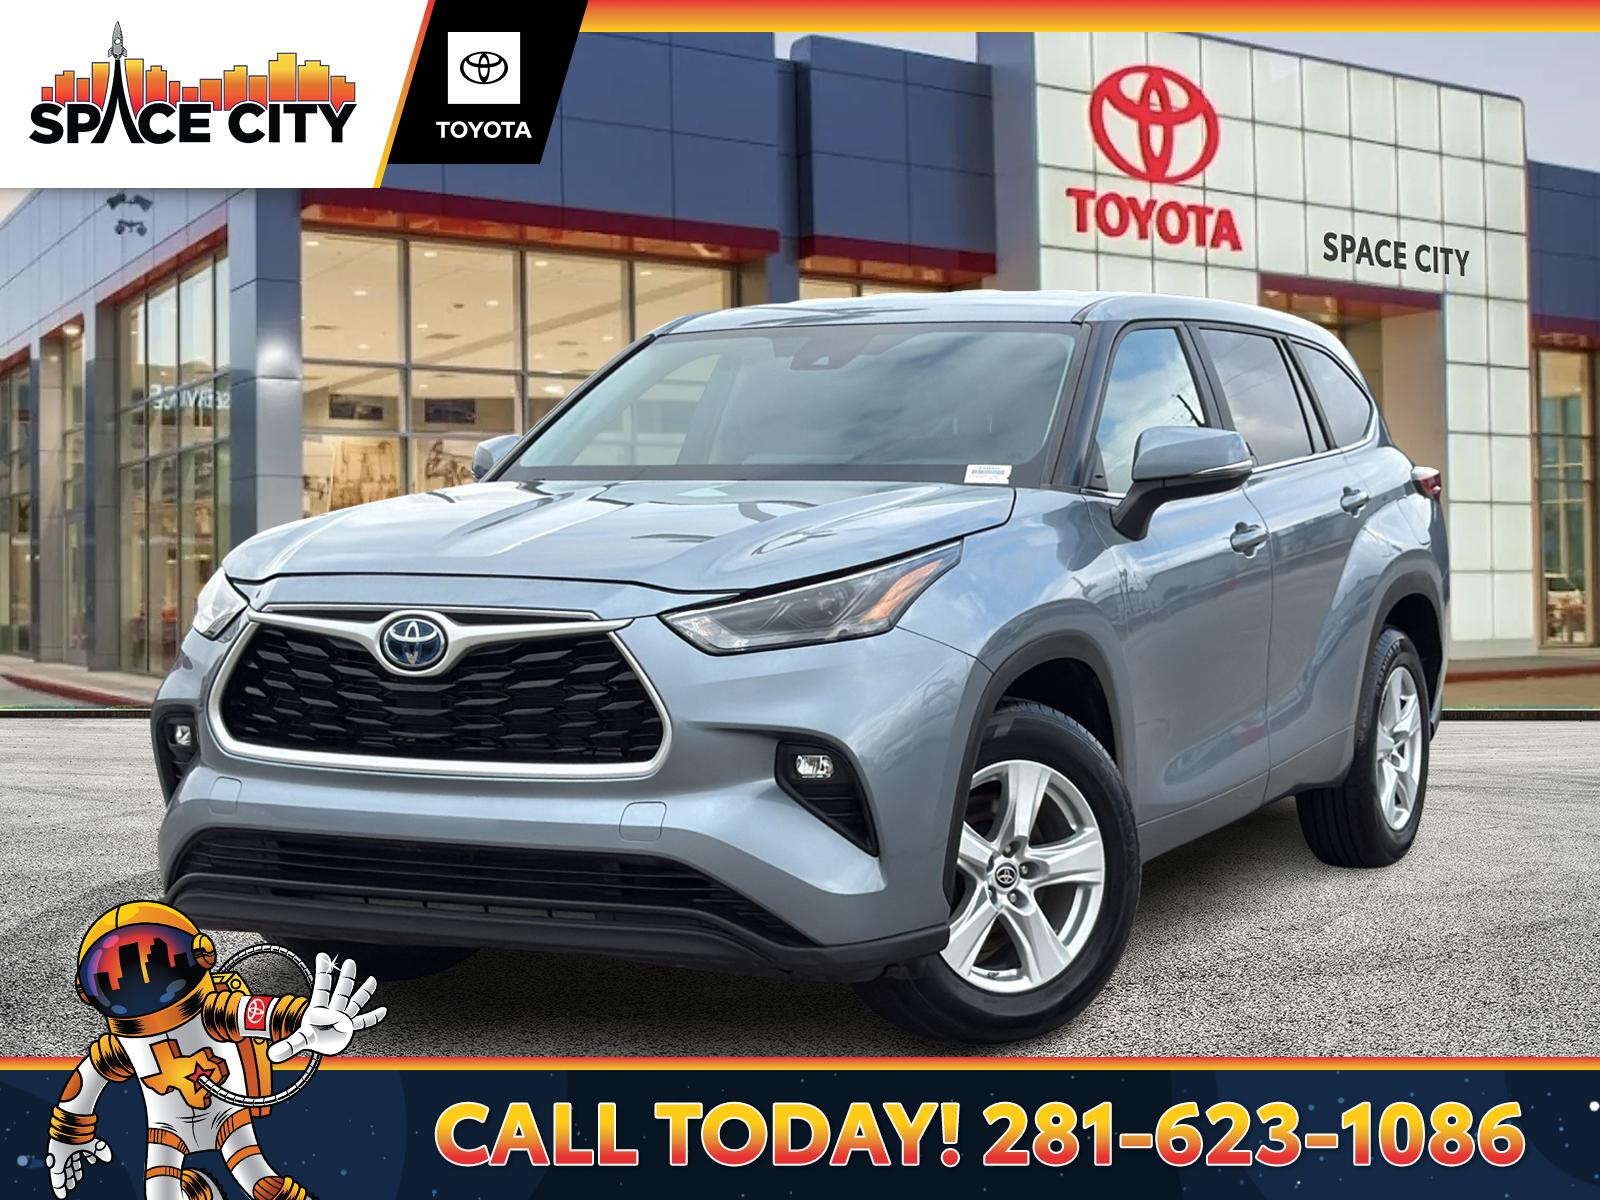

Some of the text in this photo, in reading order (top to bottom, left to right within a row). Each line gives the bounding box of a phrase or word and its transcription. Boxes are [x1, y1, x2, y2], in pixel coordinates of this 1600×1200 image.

[1066, 186, 1243, 252] TOYOTA
[1322, 231, 1471, 277] SPACE CITY
